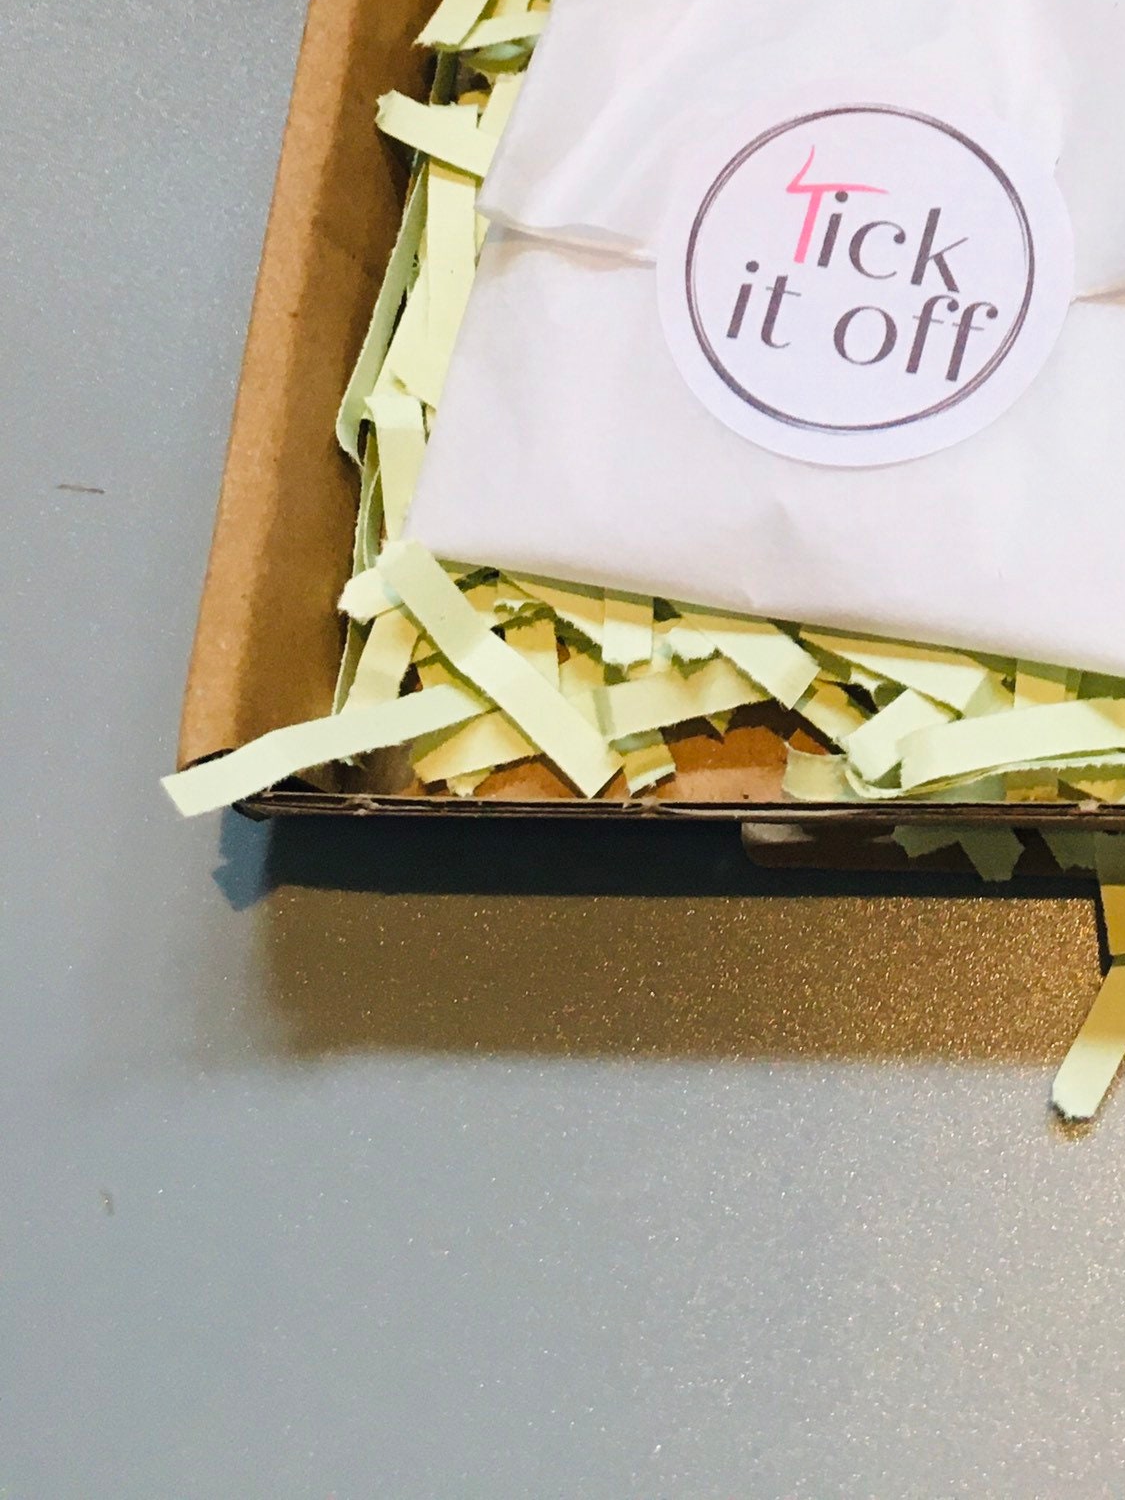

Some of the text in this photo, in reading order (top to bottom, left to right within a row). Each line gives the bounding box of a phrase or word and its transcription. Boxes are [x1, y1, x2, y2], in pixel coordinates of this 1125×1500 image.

[786, 144, 969, 293] Tick
[726, 260, 999, 382] it off
